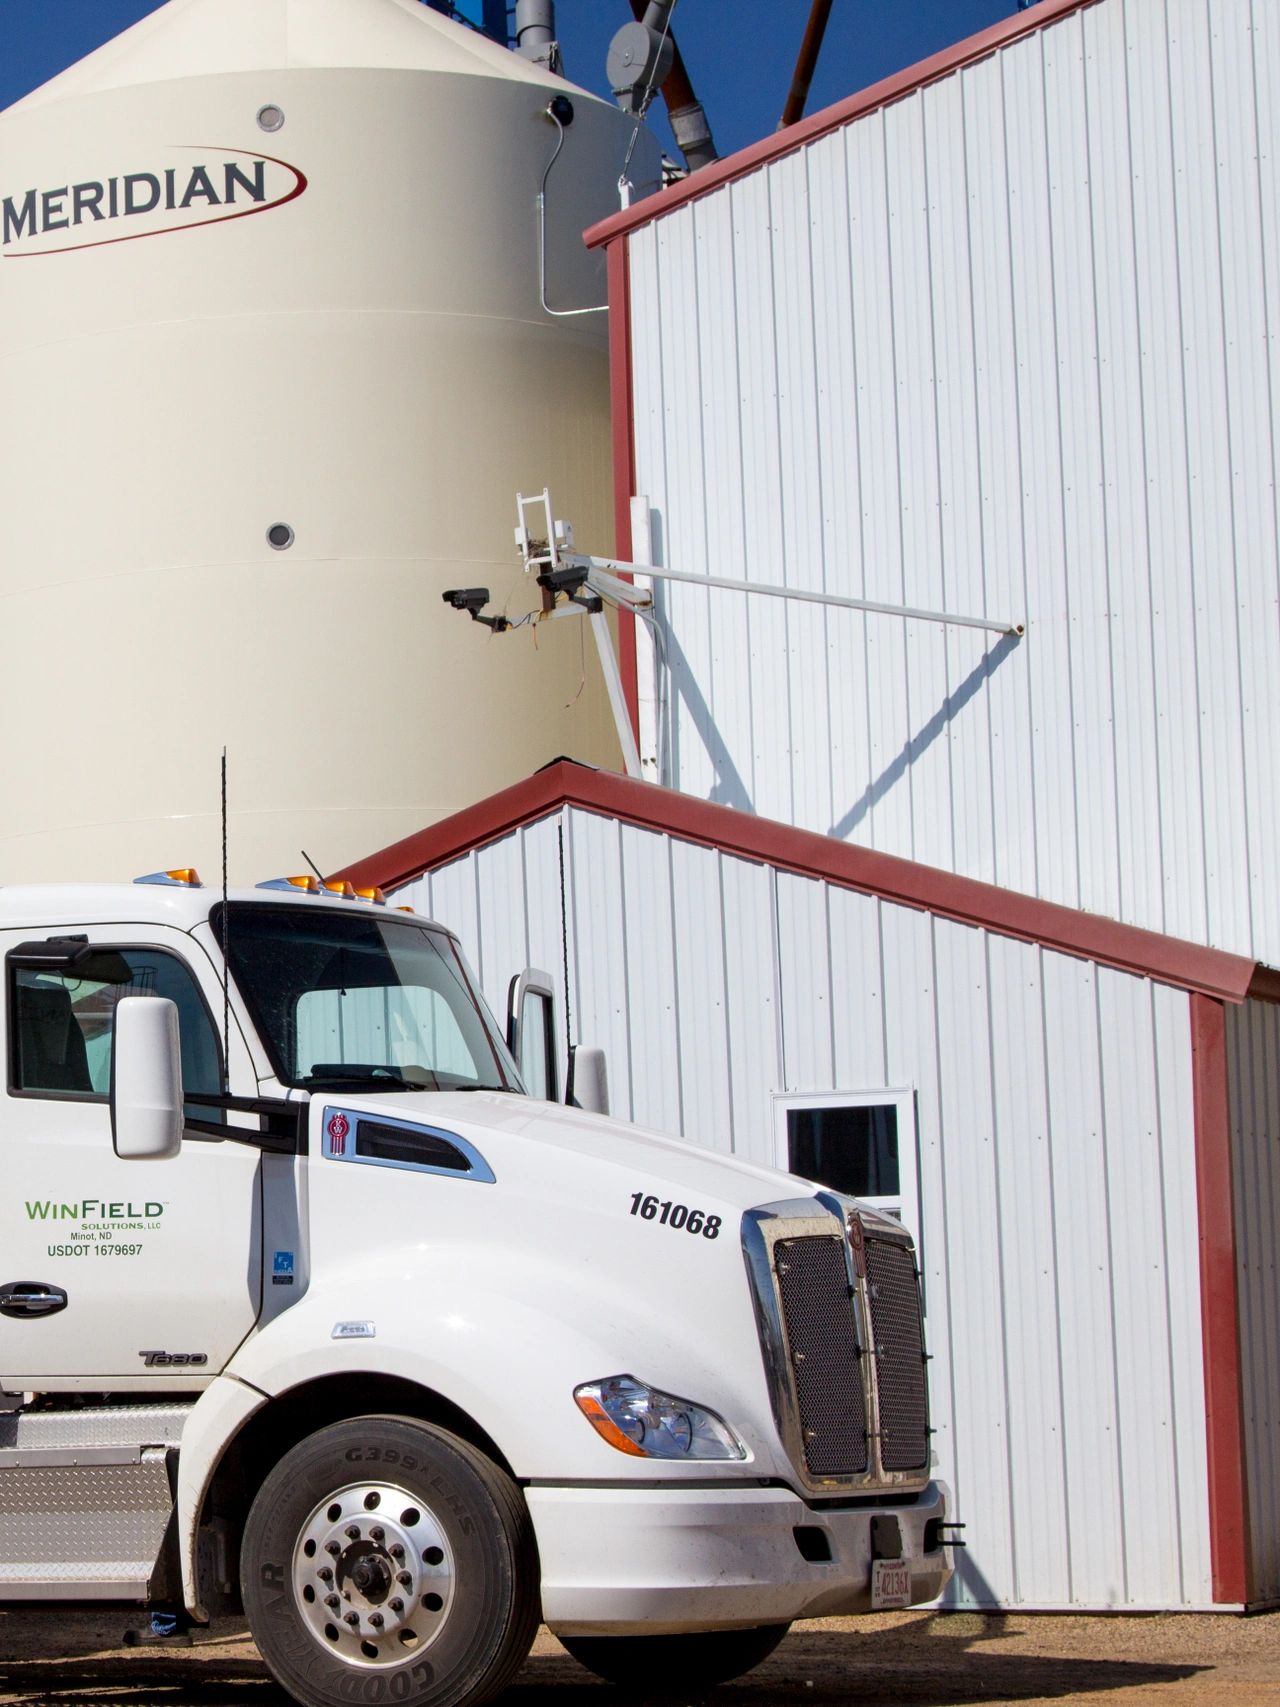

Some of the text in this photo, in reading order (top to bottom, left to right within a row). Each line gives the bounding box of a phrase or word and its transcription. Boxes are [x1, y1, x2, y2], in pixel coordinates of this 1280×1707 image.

[2, 160, 266, 245] MERIDIAN
[630, 1191, 723, 1240] 161068
[147, 1222, 161, 1230] LLC
[70, 1231, 113, 1241] Minot, ND
[47, 1243, 143, 1257] USDOT 1679697
